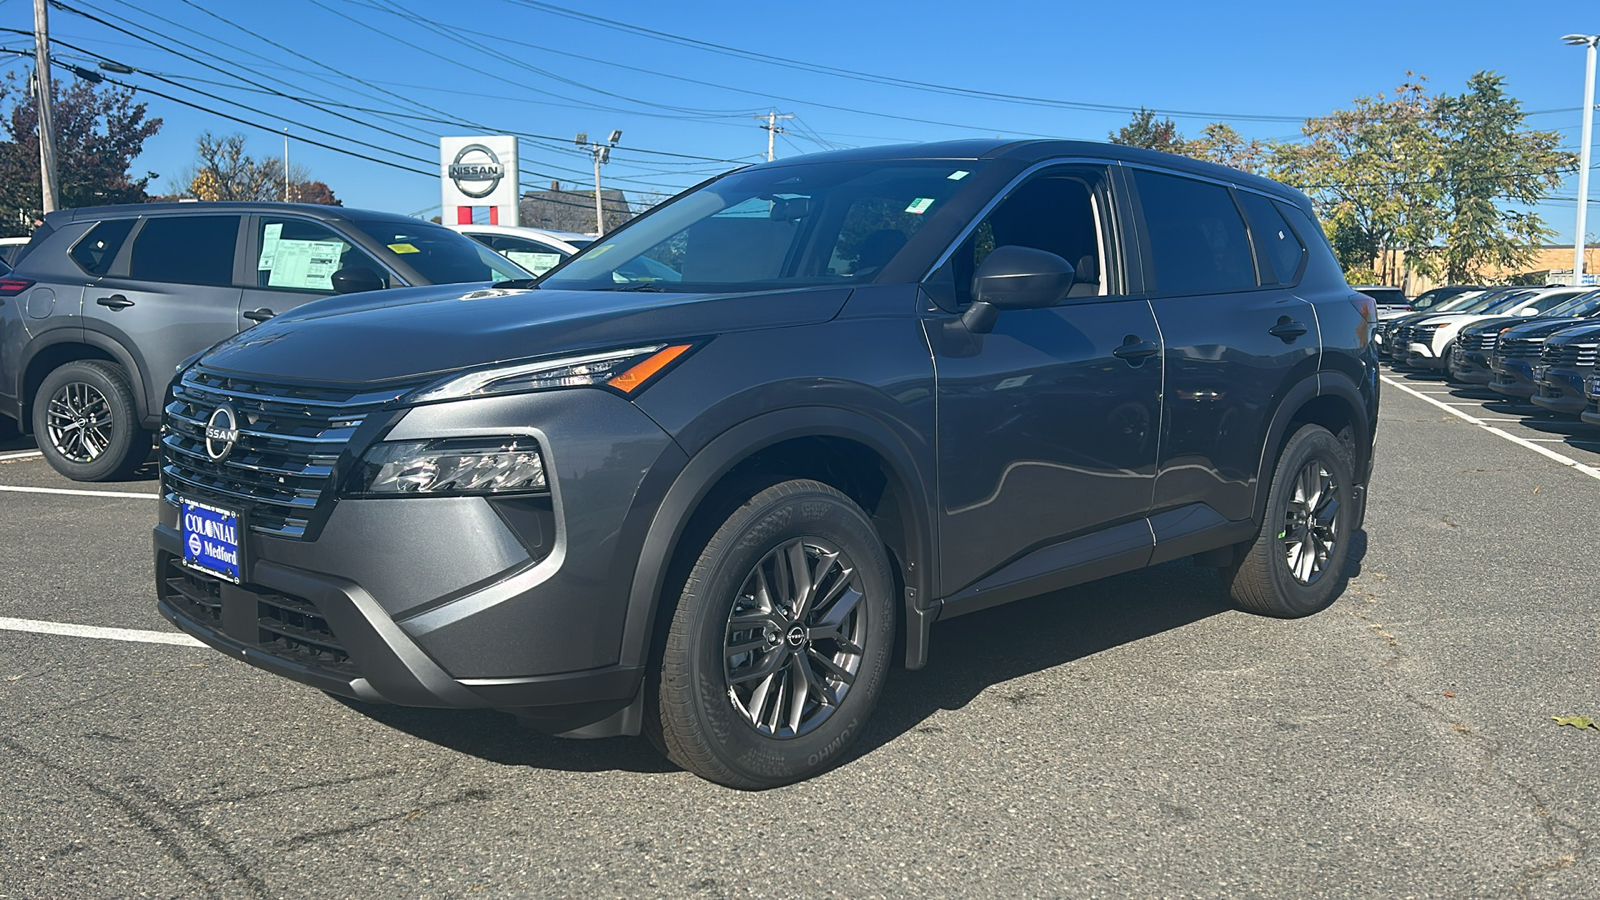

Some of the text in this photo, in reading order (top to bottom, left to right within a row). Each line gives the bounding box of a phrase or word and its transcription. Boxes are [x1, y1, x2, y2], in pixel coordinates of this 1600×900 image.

[452, 166, 498, 175] NISSAN
[206, 427, 238, 441] SSAN
[185, 513, 238, 546] COLONIAL
[204, 540, 237, 565] Medford
[807, 718, 859, 766] KUMHO
